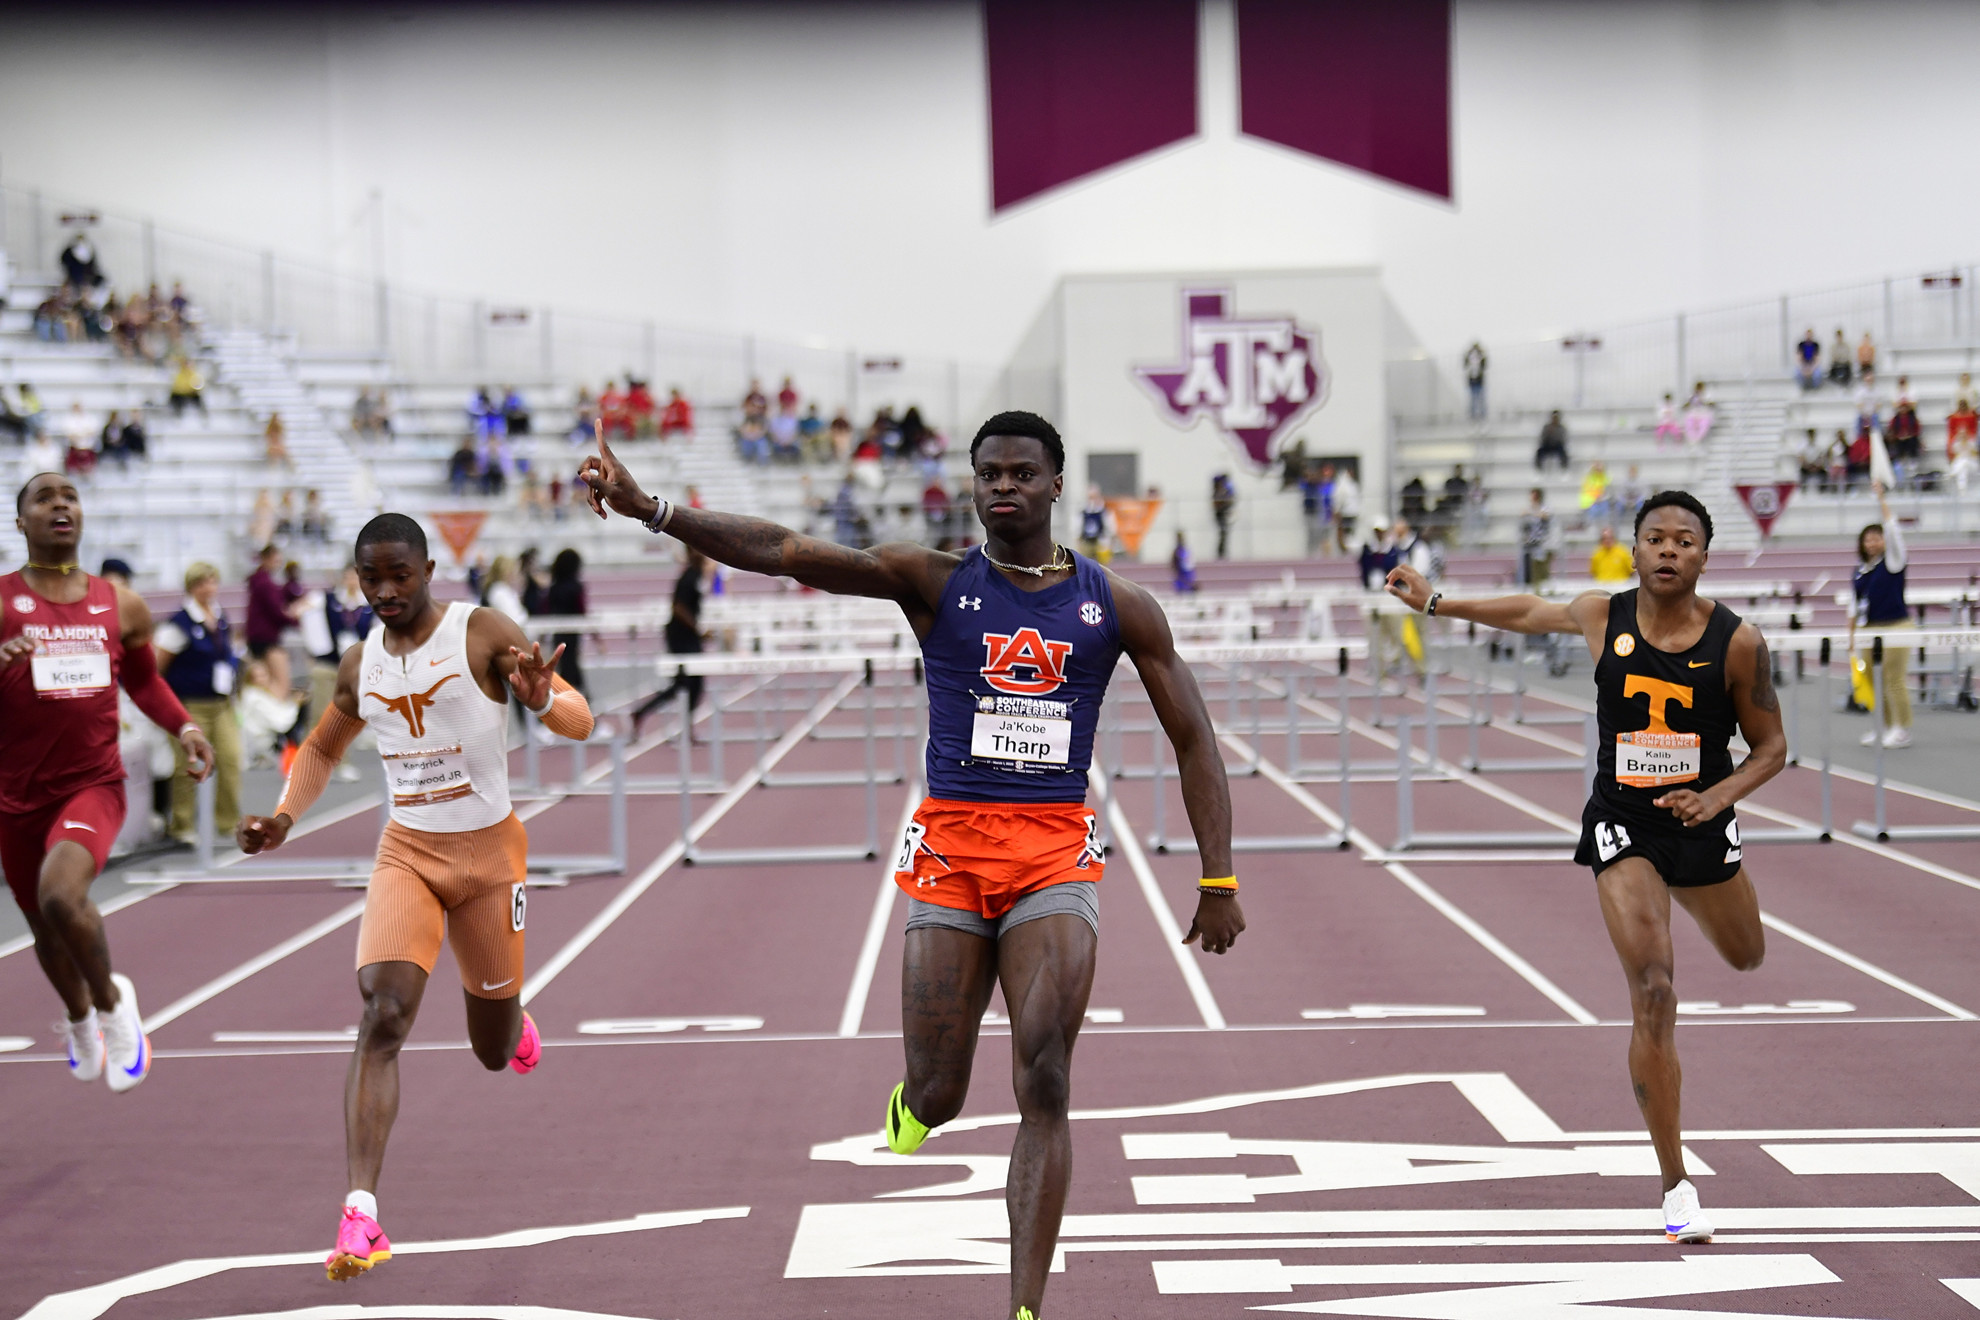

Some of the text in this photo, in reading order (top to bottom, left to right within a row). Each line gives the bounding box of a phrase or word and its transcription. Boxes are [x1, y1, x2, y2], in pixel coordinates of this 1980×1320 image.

[1081, 603, 1103, 624] SEC
[23, 625, 108, 641] OKLAHOMA
[1615, 636, 1635, 654] SEC
[52, 672, 94, 684] Kiser
[996, 696, 1067, 710] SOUTHEASTERN
[996, 704, 1067, 717] CONFERENCE
[999, 721, 1047, 734] Ja'Kobe
[1634, 732, 1696, 741] SOUTHEASTERN
[1634, 738, 1696, 747] CONFERENCE
[991, 734, 1051, 760] Tharp
[1645, 750, 1672, 759] Kalib
[403, 758, 445, 770] Kendrick
[1627, 759, 1690, 773] Branch
[396, 770, 462, 787] Smallwood JR
[898, 826, 920, 868] 5
[515, 887, 524, 927] 6
